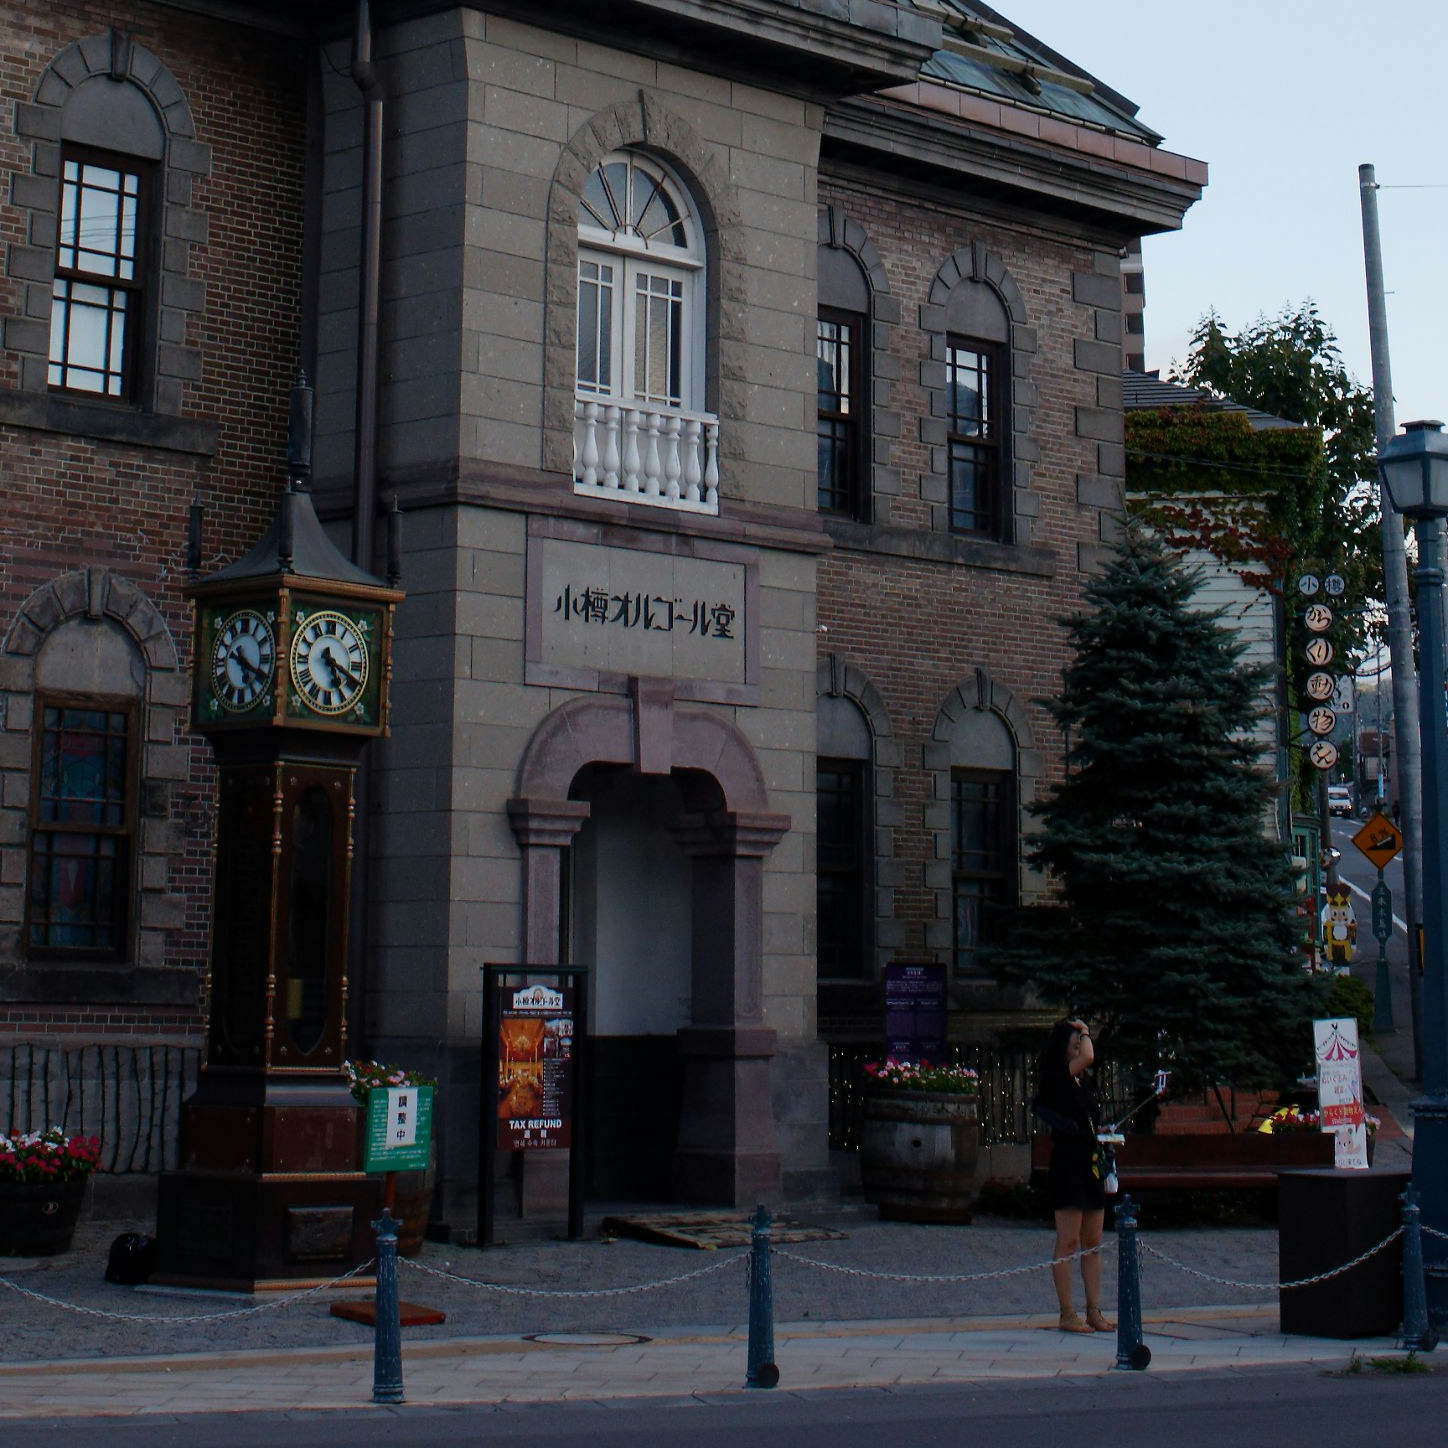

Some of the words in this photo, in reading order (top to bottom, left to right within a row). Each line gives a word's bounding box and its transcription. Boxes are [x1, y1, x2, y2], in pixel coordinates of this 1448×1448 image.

[553, 584, 735, 639] 小樽オルゴール堂
[396, 1095, 408, 1140] 調整中
[508, 1120, 527, 1130] TAX
[528, 1119, 562, 1129] REFUND
